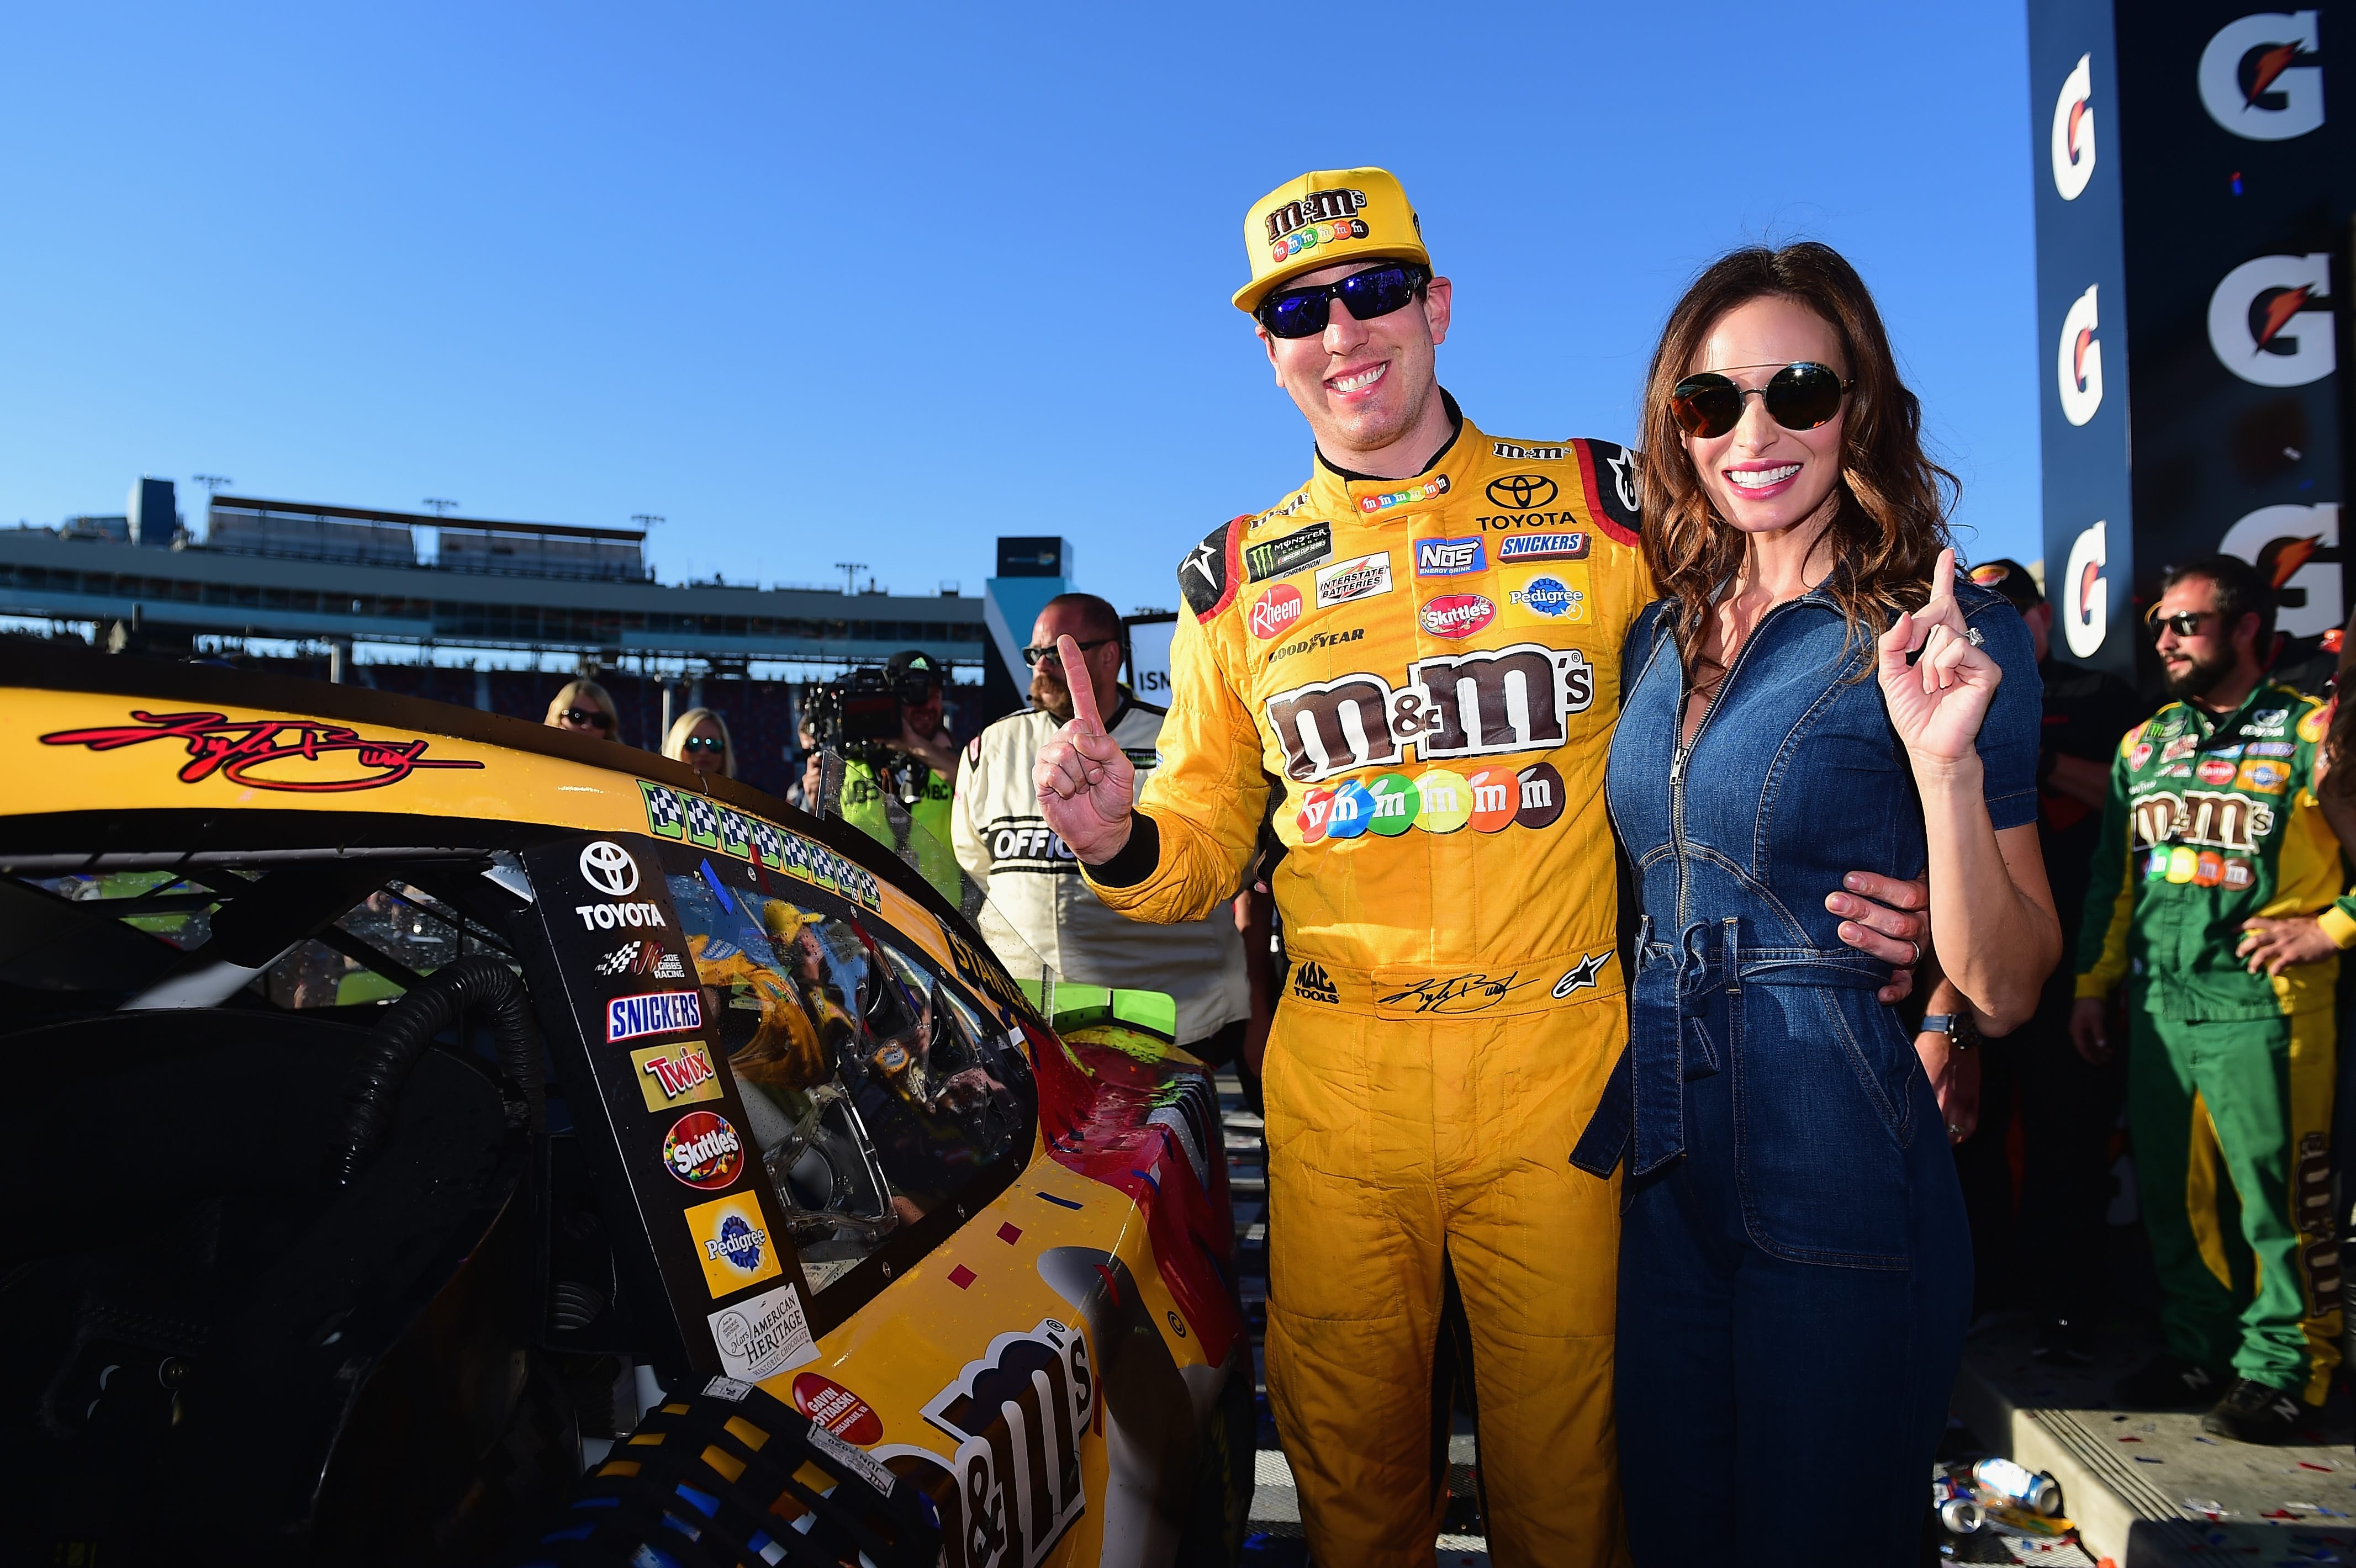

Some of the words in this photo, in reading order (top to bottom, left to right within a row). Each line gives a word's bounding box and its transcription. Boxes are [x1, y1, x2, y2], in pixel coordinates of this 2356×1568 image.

[2197, 10, 2326, 141] G
[2052, 52, 2096, 200] G
[2207, 252, 2336, 388] G
[2058, 283, 2103, 426] G
[1476, 512, 1577, 531] TOYOTA
[1274, 528, 1327, 551] MONSTER
[1300, 547, 1310, 555] CUP
[1503, 534, 1579, 554] SNICKERS
[1419, 539, 1479, 568] NOS
[1283, 559, 1321, 578] CHAMPION
[1320, 567, 1385, 591] INTERSTATE
[1322, 576, 1381, 598] BATTERIES
[1509, 590, 1583, 604] Pedigree
[2064, 520, 2107, 658] G
[1254, 589, 1301, 635] Rheem
[1426, 603, 1491, 628] Skittles
[575, 903, 666, 930] TOYOTA
[659, 962, 682, 970] GIBBS
[663, 953, 679, 962] JOE
[654, 970, 685, 978] RACING
[1295, 961, 1337, 994] MAC
[1294, 986, 1339, 1004] TOOLS
[612, 994, 700, 1037] SNICKERS
[673, 1130, 739, 1173] Skittles
[705, 1229, 765, 1260] Pedigree
[753, 1295, 796, 1338] AMERICAN
[731, 1331, 749, 1354] Mars
[744, 1310, 802, 1365] HERITAGE
[753, 1354, 781, 1376] HISTORIC
[781, 1331, 808, 1357] CHOCOLATE
[807, 1387, 839, 1412] GAVIN
[812, 1391, 856, 1426] OTTARSKI
[861, 1406, 869, 1414] VA
